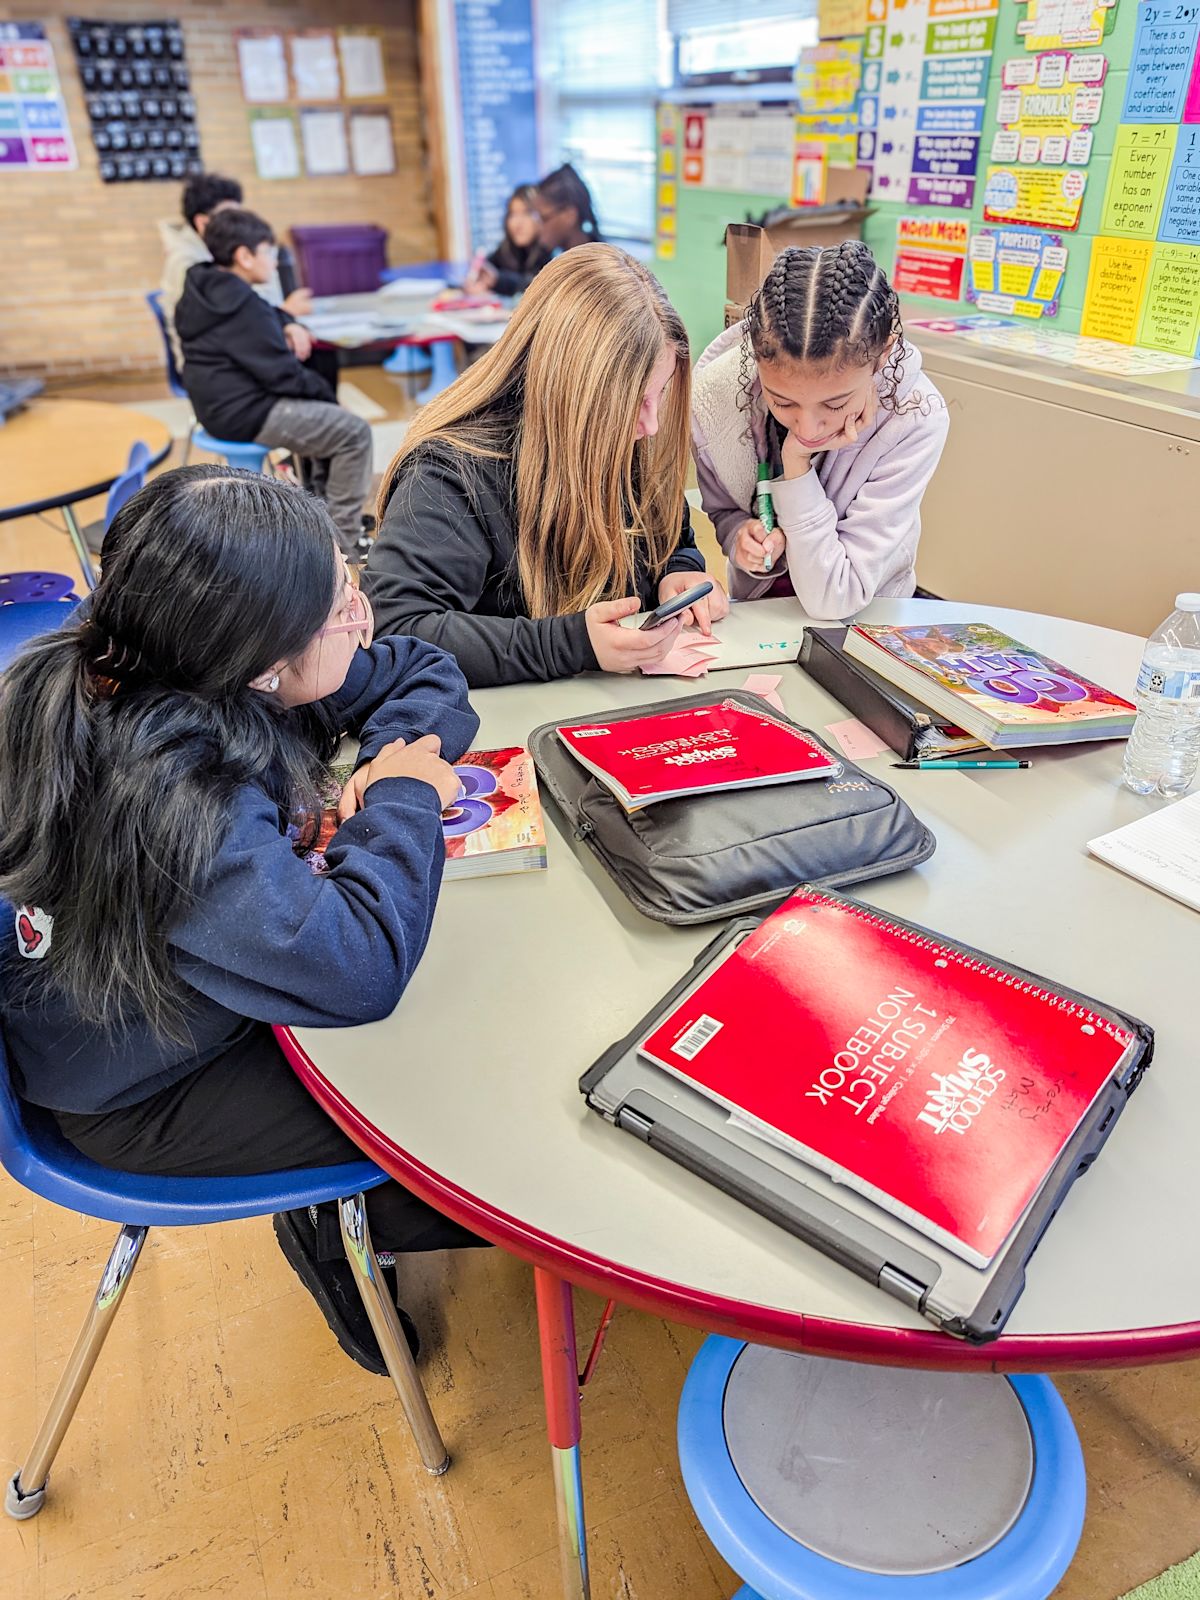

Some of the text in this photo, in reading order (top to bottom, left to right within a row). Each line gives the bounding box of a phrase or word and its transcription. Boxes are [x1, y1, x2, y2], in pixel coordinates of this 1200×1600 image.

[1144, 7, 1160, 24] 2y
[934, 25, 949, 37] The
[1150, 29, 1168, 41] There
[1170, 29, 1177, 40] is
[867, 26, 882, 57] 5
[1140, 44, 1190, 58] multiplication
[928, 61, 943, 72] The
[1136, 59, 1185, 75] sign between
[863, 63, 879, 93] 6
[1146, 76, 1168, 87] every
[1133, 87, 1176, 99] coefficient
[1023, 93, 1073, 117] FORMULAS
[1127, 102, 1176, 113] and variable.
[861, 98, 875, 127] 8
[918, 137, 934, 149] The
[1131, 132, 1138, 145] 7
[1190, 132, 1196, 146] 1
[860, 132, 874, 160] 9
[1130, 149, 1157, 166] Every
[1123, 166, 1157, 180] number
[1182, 169, 1196, 180] One
[917, 178, 933, 190] The
[1122, 182, 1151, 197] has an
[1176, 195, 1194, 203] same
[1113, 202, 1153, 214] exponent
[1169, 204, 1196, 215] variable
[1115, 214, 1146, 229] of one.
[1168, 217, 1197, 229] negative
[998, 231, 1043, 250] PROPERTIES
[1109, 258, 1133, 271] Use the
[1164, 262, 1198, 275] A negative
[1099, 268, 1137, 283] distributive
[1159, 274, 1168, 285] sign
[1172, 275, 1180, 283] to
[1180, 275, 1190, 285] the
[1153, 282, 1162, 291] of
[1168, 284, 1192, 296] number
[1156, 294, 1193, 307] parentheses
[1158, 304, 1168, 313] the
[1168, 307, 1185, 315] same
[1151, 313, 1190, 327] negative one
[1155, 325, 1182, 336] times the
[966, 669, 1088, 705] GO
[804, 985, 916, 1106] NOTEBOOK
[841, 1003, 937, 1116] 1 SUBJECT
[880, 1081, 904, 1106] College
[915, 1047, 991, 1136] SMART
[940, 1063, 1006, 1136] SCHOOL
[866, 1103, 887, 1125] Ruled
